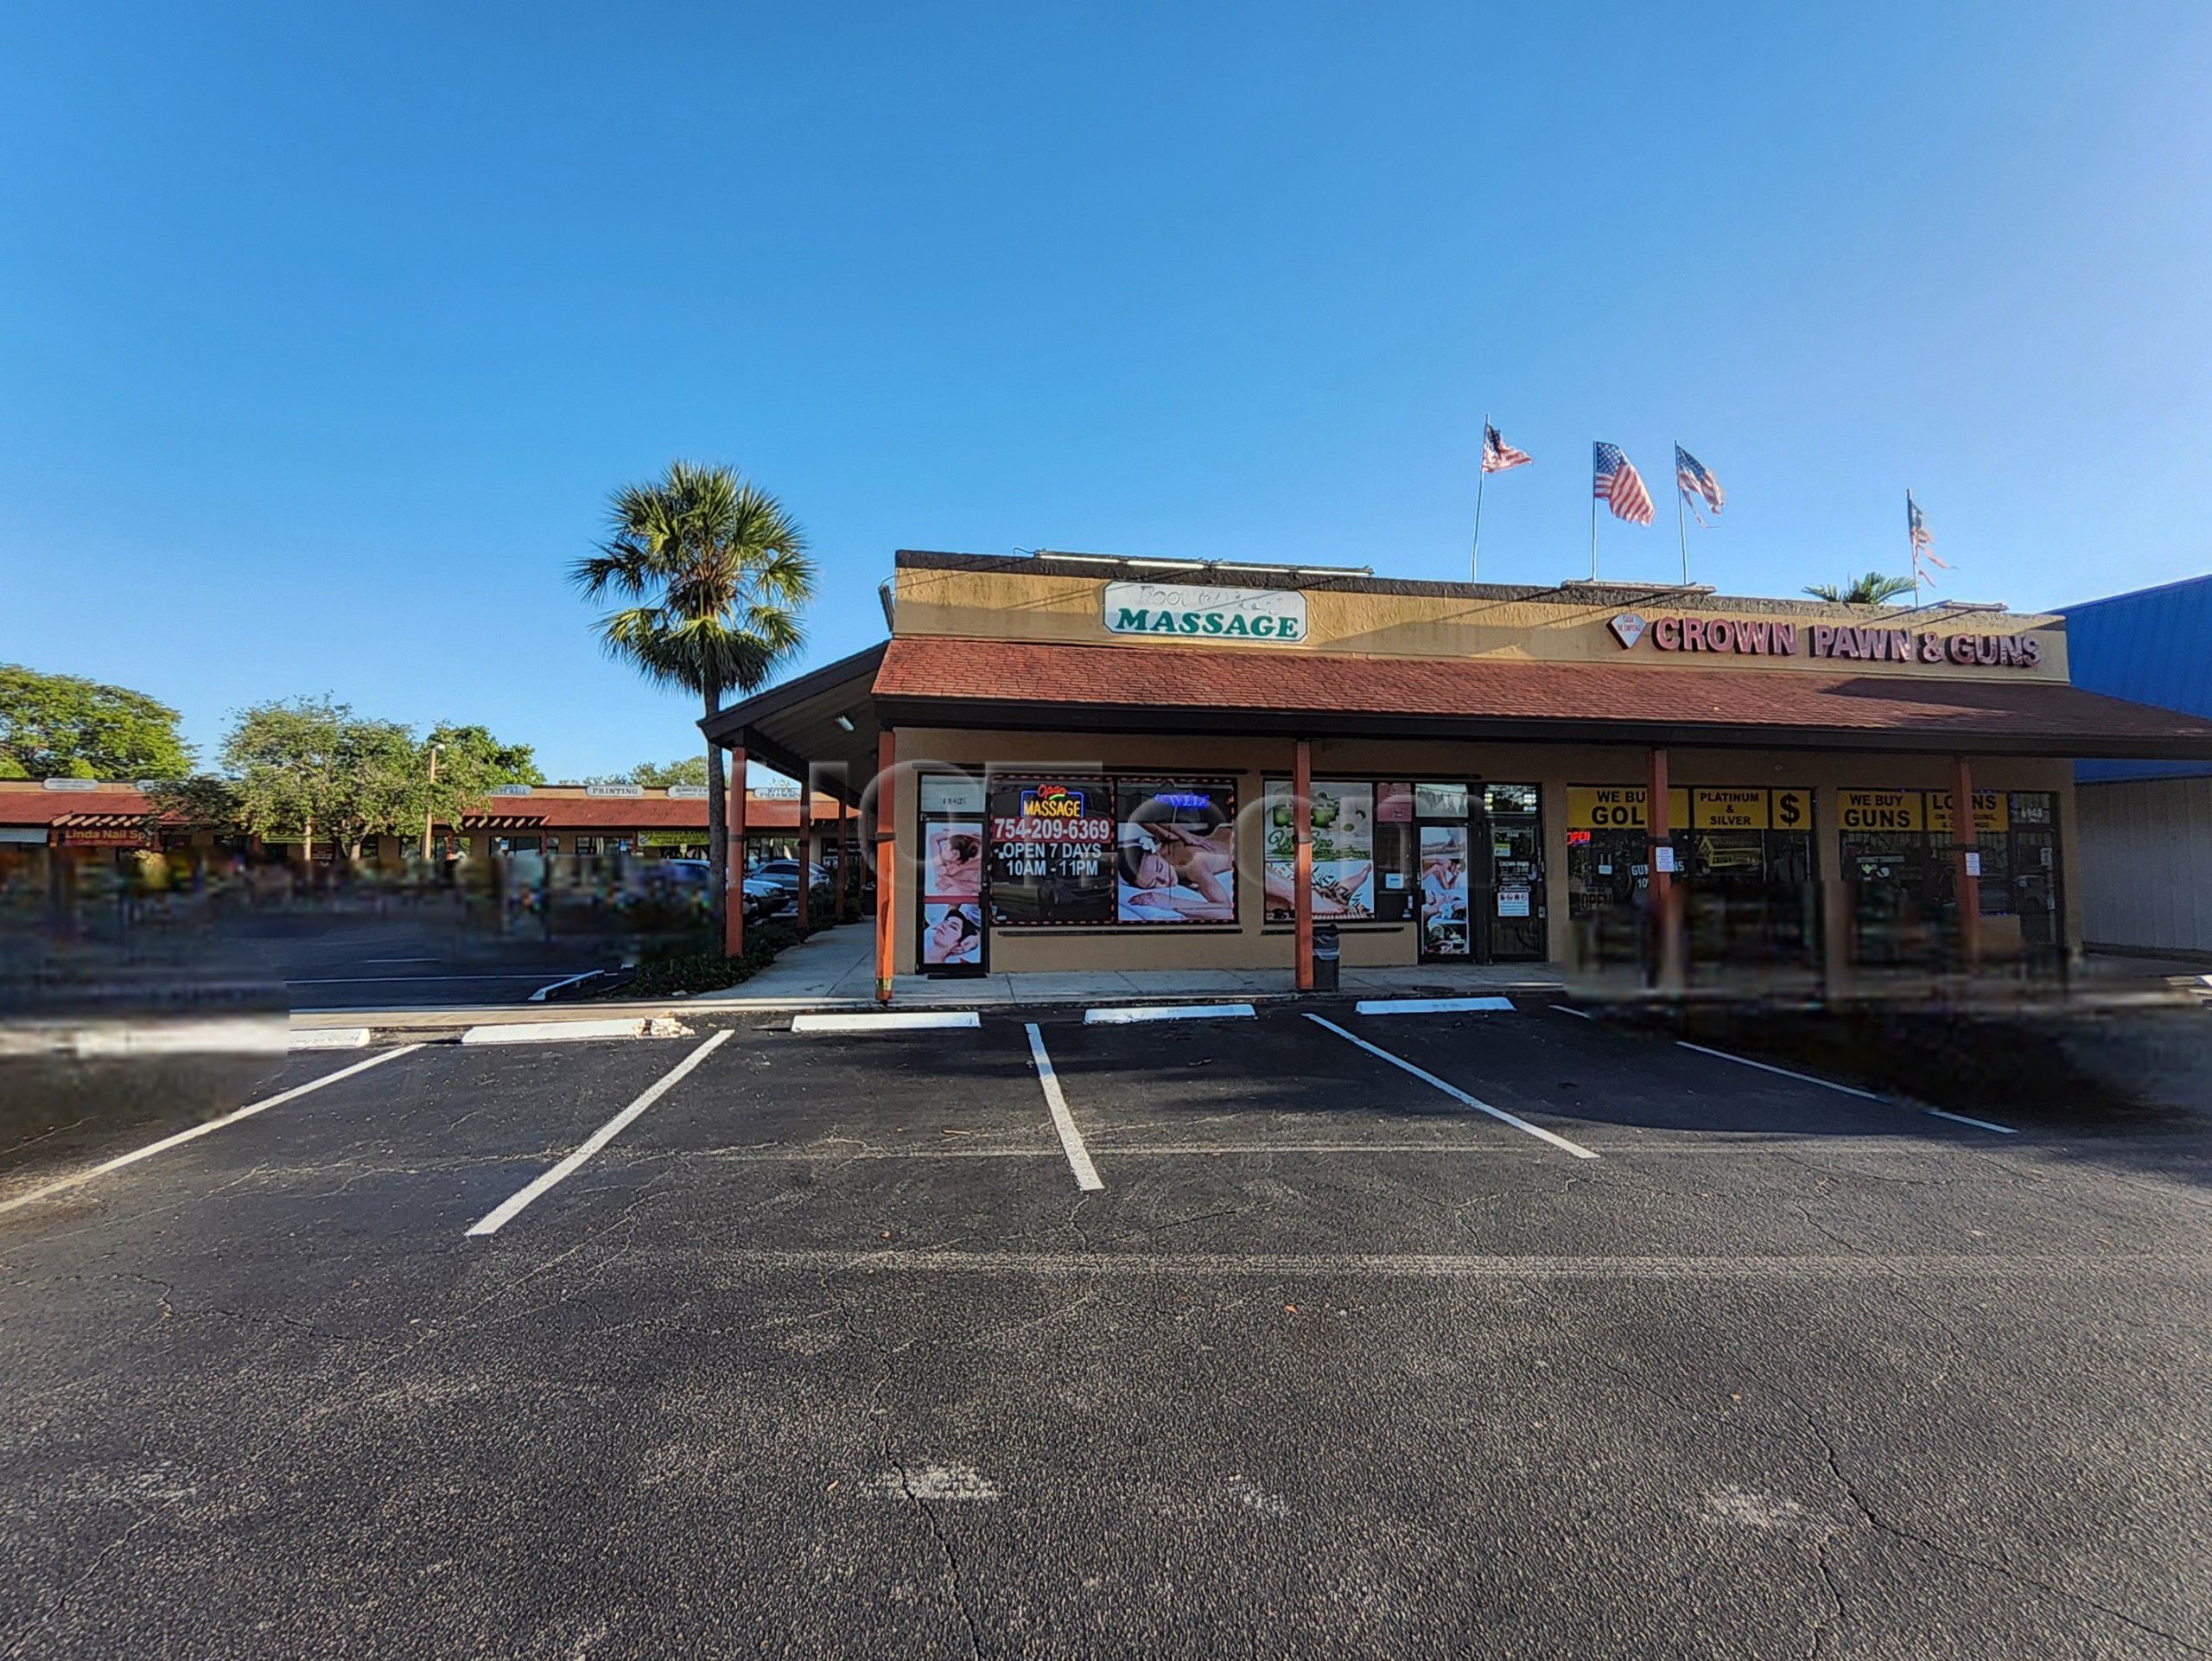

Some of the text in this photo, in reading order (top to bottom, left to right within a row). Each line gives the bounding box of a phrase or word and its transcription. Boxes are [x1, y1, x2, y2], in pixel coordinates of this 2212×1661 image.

[1116, 608, 1298, 638] MASSAGE
[1655, 615, 2042, 667] CROWN PAWN & GUNS
[1037, 784, 1067, 799] Open
[1597, 791, 1646, 803] WE BU
[1700, 792, 1759, 802] PLATINUM
[1850, 794, 1904, 805] WE BUY
[1933, 794, 1997, 811] LONS
[1023, 800, 1080, 818] MASSAGE
[1592, 806, 1645, 825] GOL
[1726, 805, 1734, 813] &
[1779, 792, 1801, 827] $
[1710, 816, 1751, 825] SILVER
[1844, 809, 1910, 828] GUNS
[66, 830, 147, 842] Linda Nail Sp
[995, 818, 1109, 840] 754-209-6369
[1566, 831, 1591, 844] OPEN
[1003, 843, 1102, 858] OPEN 7 DAYS
[1007, 860, 1046, 876] 10AM
[1059, 861, 1098, 876] 11PM
[1637, 877, 1649, 888] 10
